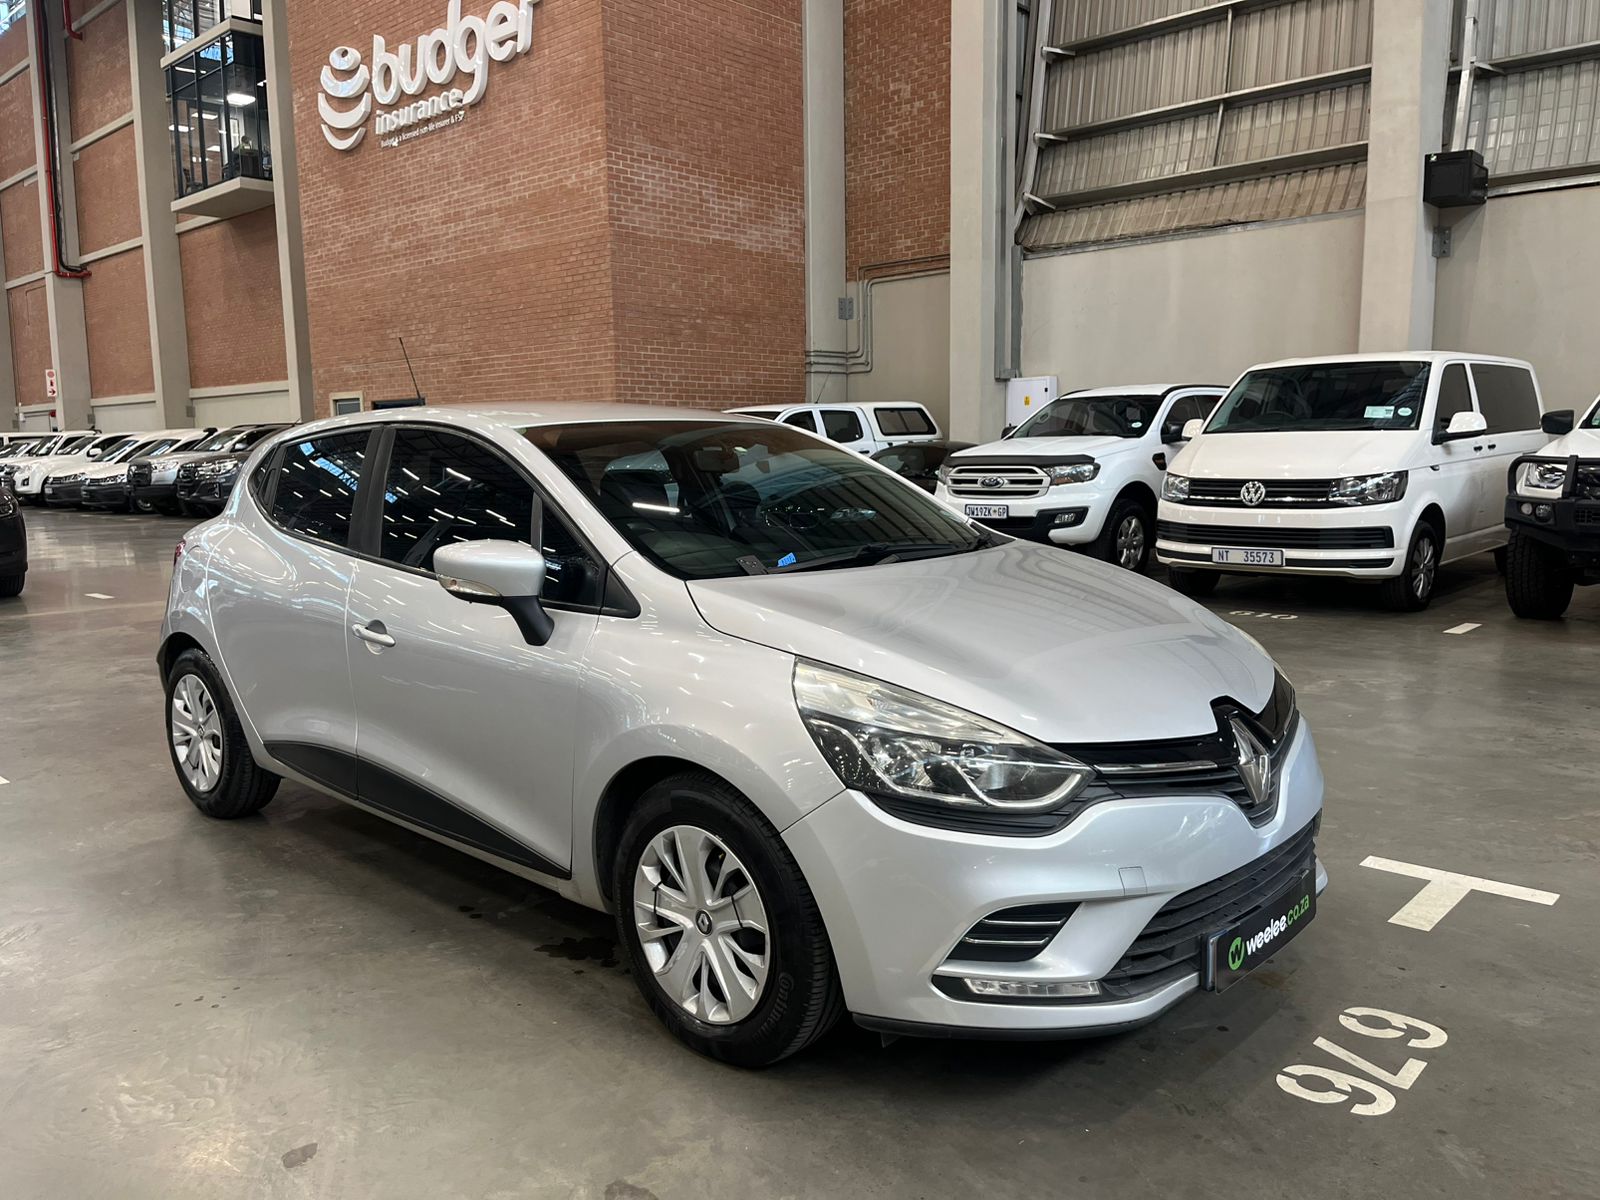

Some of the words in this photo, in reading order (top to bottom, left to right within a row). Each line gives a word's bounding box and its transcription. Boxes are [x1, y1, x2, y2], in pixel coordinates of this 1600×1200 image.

[375, 88, 464, 135] insurance
[998, 507, 1007, 517] GP
[1218, 550, 1229, 562] NT
[1243, 551, 1274, 564] 35573
[1246, 894, 1310, 956] weelee.co.za
[1275, 1006, 1449, 1117] 676
